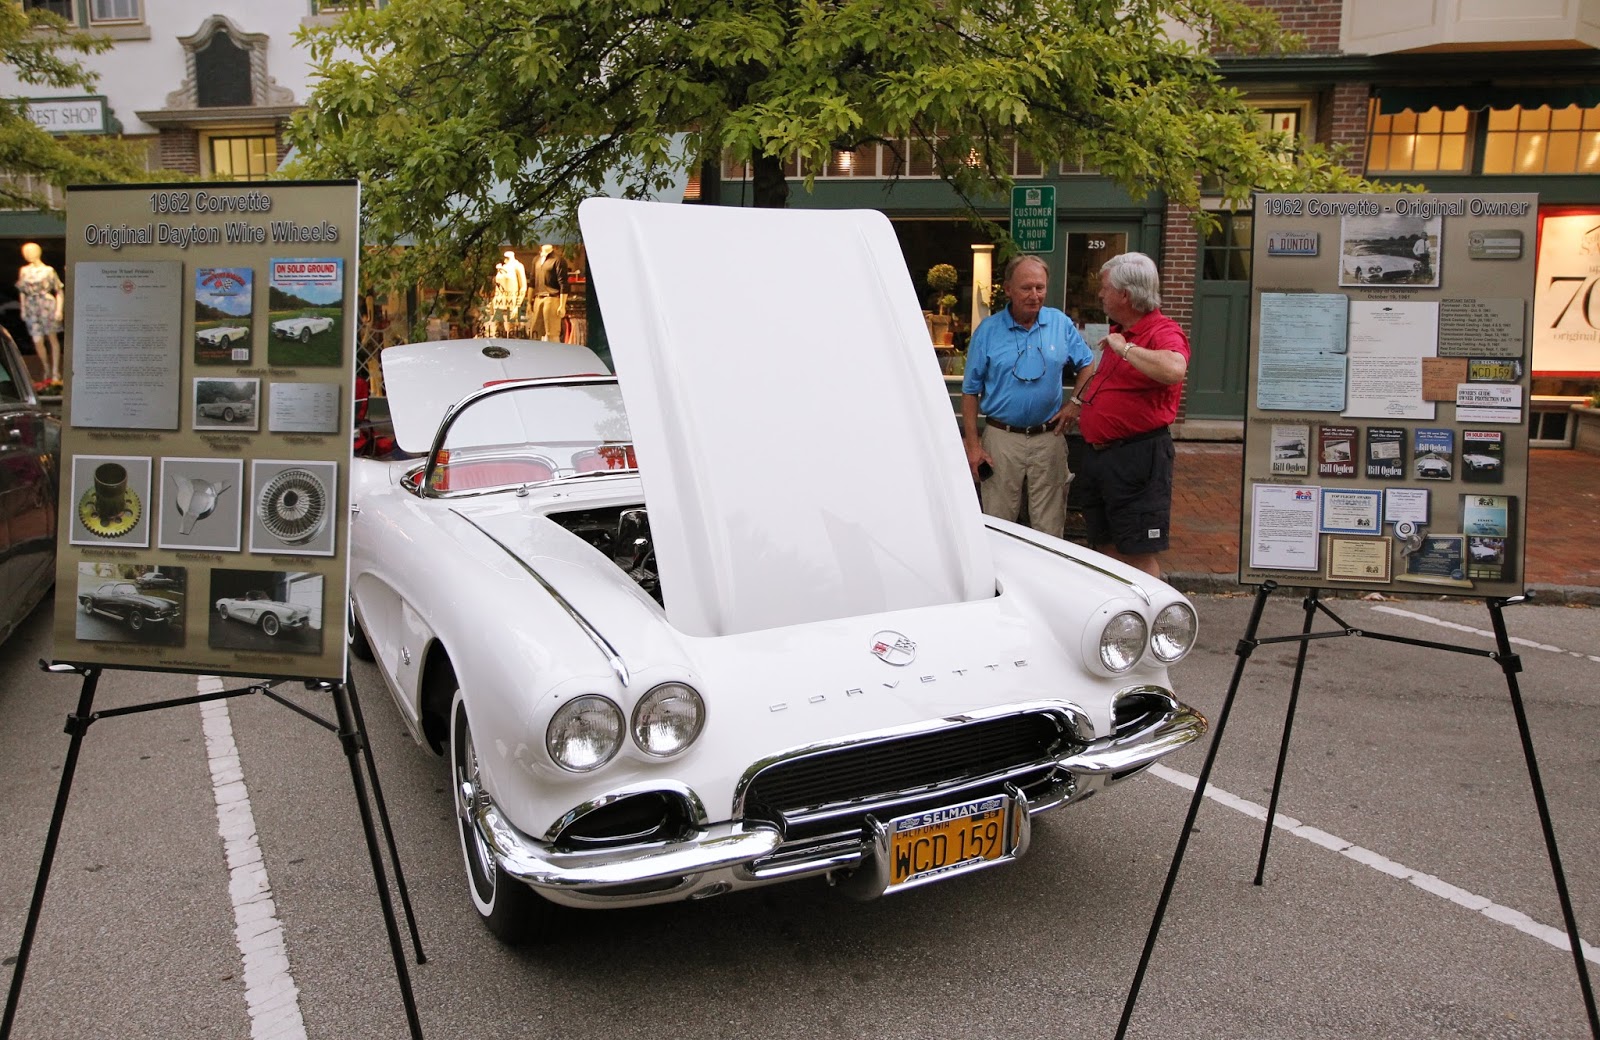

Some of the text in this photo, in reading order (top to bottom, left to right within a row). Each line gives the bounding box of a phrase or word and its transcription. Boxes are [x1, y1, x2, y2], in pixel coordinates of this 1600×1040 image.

[62, 108, 97, 124] SHOP
[150, 191, 272, 213] 1962 Corvette
[1014, 208, 1052, 216] CUSTOMER
[1264, 198, 1302, 215] 1962
[1307, 198, 1379, 216] Corvette
[1395, 198, 1464, 219] Original
[1469, 199, 1528, 216] Owner
[1018, 218, 1048, 228] PARKING
[84, 220, 338, 249] Original Dayton Wire Wheels
[1018, 230, 1046, 238] 2 HOUR
[1022, 240, 1042, 250] LIMIT
[1088, 240, 1106, 249] 259
[1269, 238, 1316, 250] A DUNTOV
[276, 264, 335, 274] ON SOLID GROUND
[1472, 368, 1510, 378] WCD 159
[1273, 462, 1306, 472] Bill Ogden
[1320, 464, 1354, 474] Bill Ogden
[1368, 465, 1402, 477] Bill Ogden
[770, 659, 1028, 712] CORVETTE
[923, 804, 978, 826] SELMAN
[896, 834, 947, 879] WCD
[955, 822, 999, 862] 159
